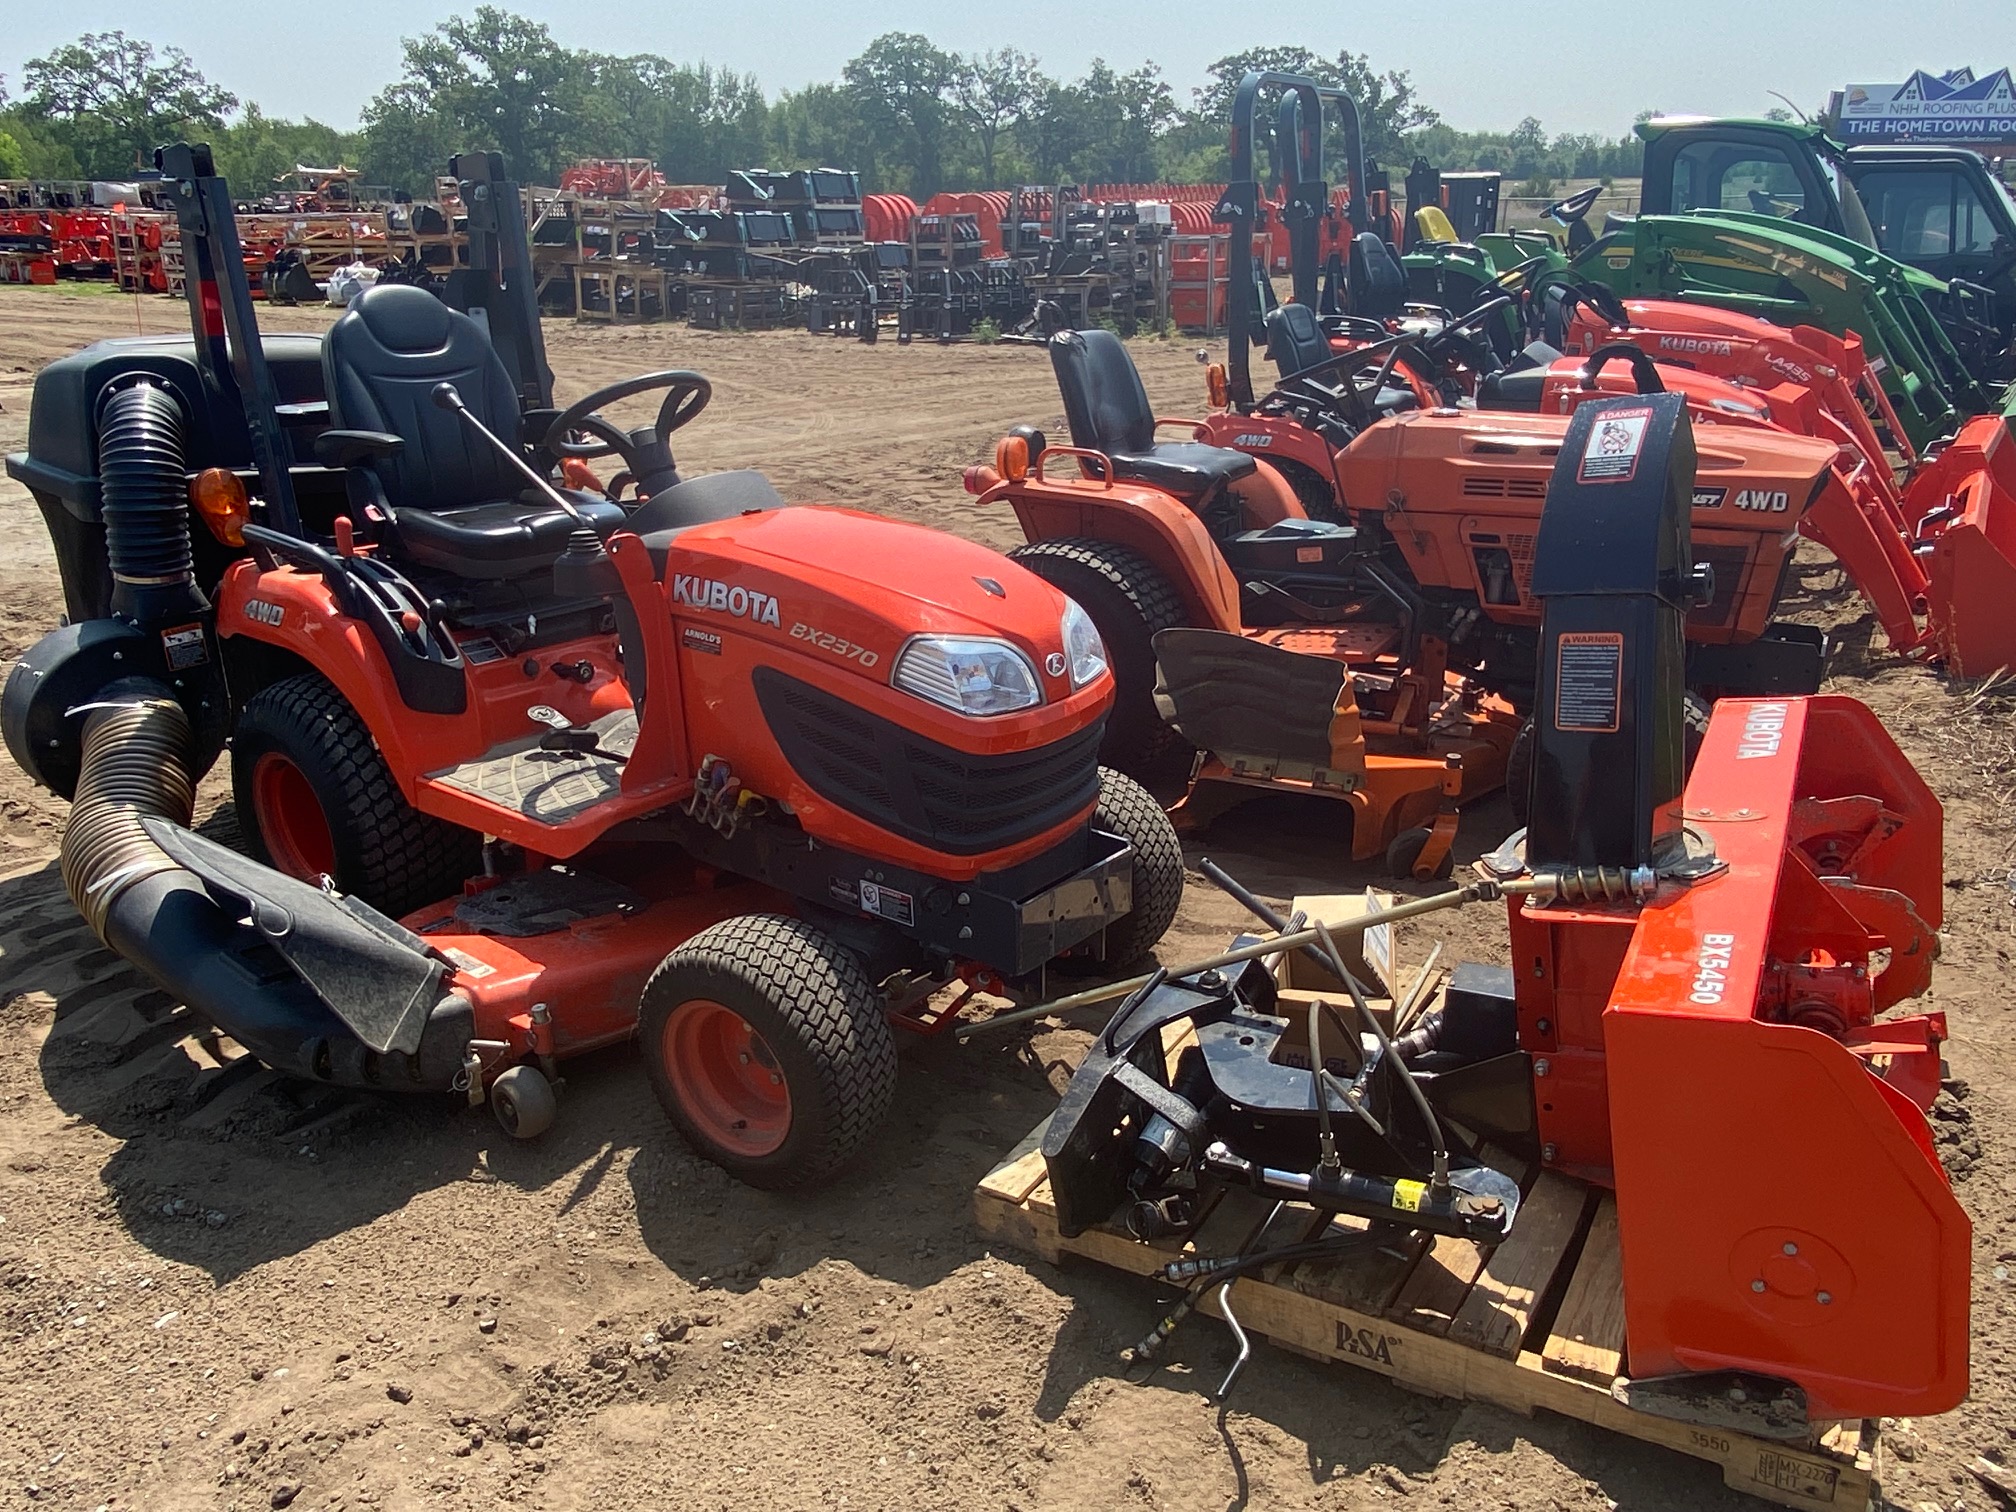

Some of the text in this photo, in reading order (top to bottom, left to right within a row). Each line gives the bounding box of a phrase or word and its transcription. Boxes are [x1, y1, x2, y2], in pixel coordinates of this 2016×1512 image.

[1889, 102, 1919, 114] NHH
[1923, 102, 1983, 114] ROOFING
[1987, 102, 2016, 114] PLUS
[1849, 120, 1881, 133] THE
[1884, 119, 1984, 133] HOMETOWN
[1659, 335, 1732, 357] KUBOTA
[1764, 352, 1812, 383] LA435
[1607, 408, 1649, 420] DANGER
[1232, 433, 1273, 448] 4WD
[1734, 489, 1788, 513] 4WD
[244, 598, 285, 627] 4WD
[672, 572, 782, 630] KUBOTA
[683, 627, 722, 645] ARNOLD'S
[788, 621, 880, 668] BX2370
[1571, 634, 1619, 644] WARNING
[1735, 702, 1789, 761] KUBOTA
[1688, 932, 1736, 1006] BX5450
[1689, 1430, 1731, 1453] 3550
